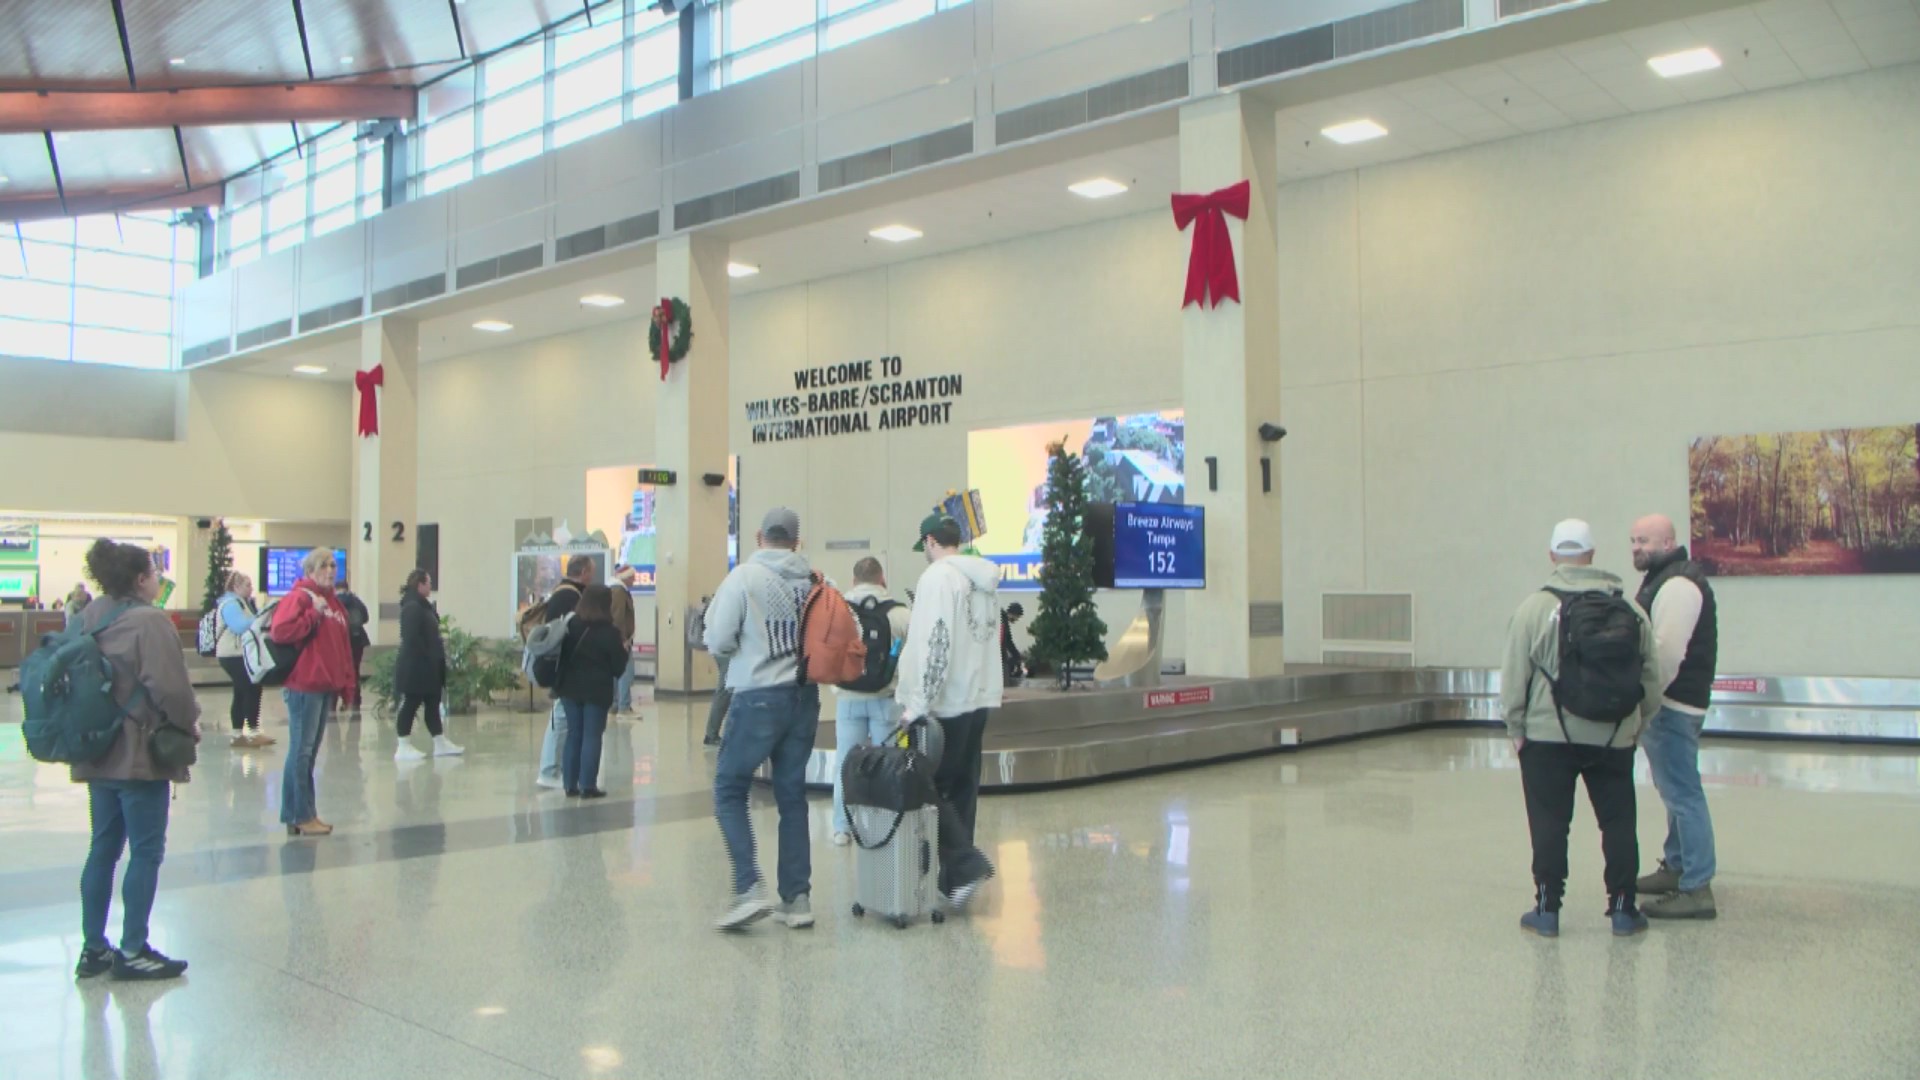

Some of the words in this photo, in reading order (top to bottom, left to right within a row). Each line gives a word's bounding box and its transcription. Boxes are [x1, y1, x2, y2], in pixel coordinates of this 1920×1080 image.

[794, 360, 872, 390] WELCOME
[880, 356, 902, 378] TO
[745, 374, 962, 421] WILKES-BARRE/SCRANTON
[752, 411, 871, 444] INTERNATIONAL
[879, 401, 953, 430] AIRPORT
[1204, 456, 1217, 492] 1
[363, 521, 373, 542] 2
[391, 521, 405, 542] 2
[1127, 513, 1159, 528] Breeze
[1160, 516, 1194, 532] Airways
[1147, 531, 1176, 548] Tampa
[1148, 552, 1176, 574] 152
